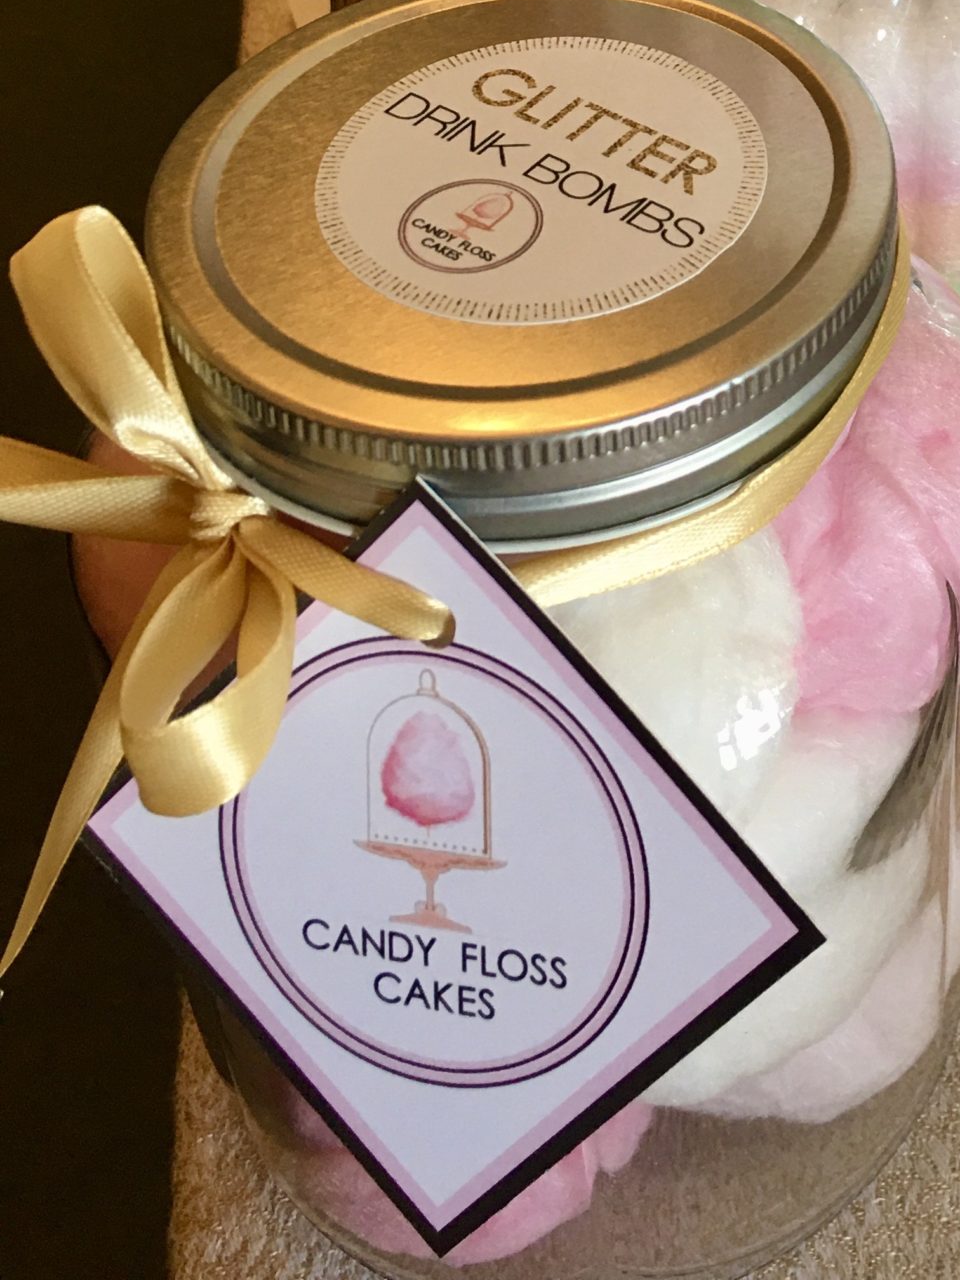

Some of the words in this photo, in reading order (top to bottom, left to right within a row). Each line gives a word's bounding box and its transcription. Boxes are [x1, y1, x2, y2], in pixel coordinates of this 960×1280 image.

[471, 68, 718, 196] GLITTER
[384, 92, 531, 167] DRINK
[523, 154, 706, 249] BOMBS
[411, 218, 457, 242] CANDY
[458, 240, 496, 262] FLOSS
[421, 237, 463, 261] CAKES
[302, 918, 437, 967] CANDY
[460, 942, 568, 989] FLOSS
[373, 971, 496, 1020] CAKES
